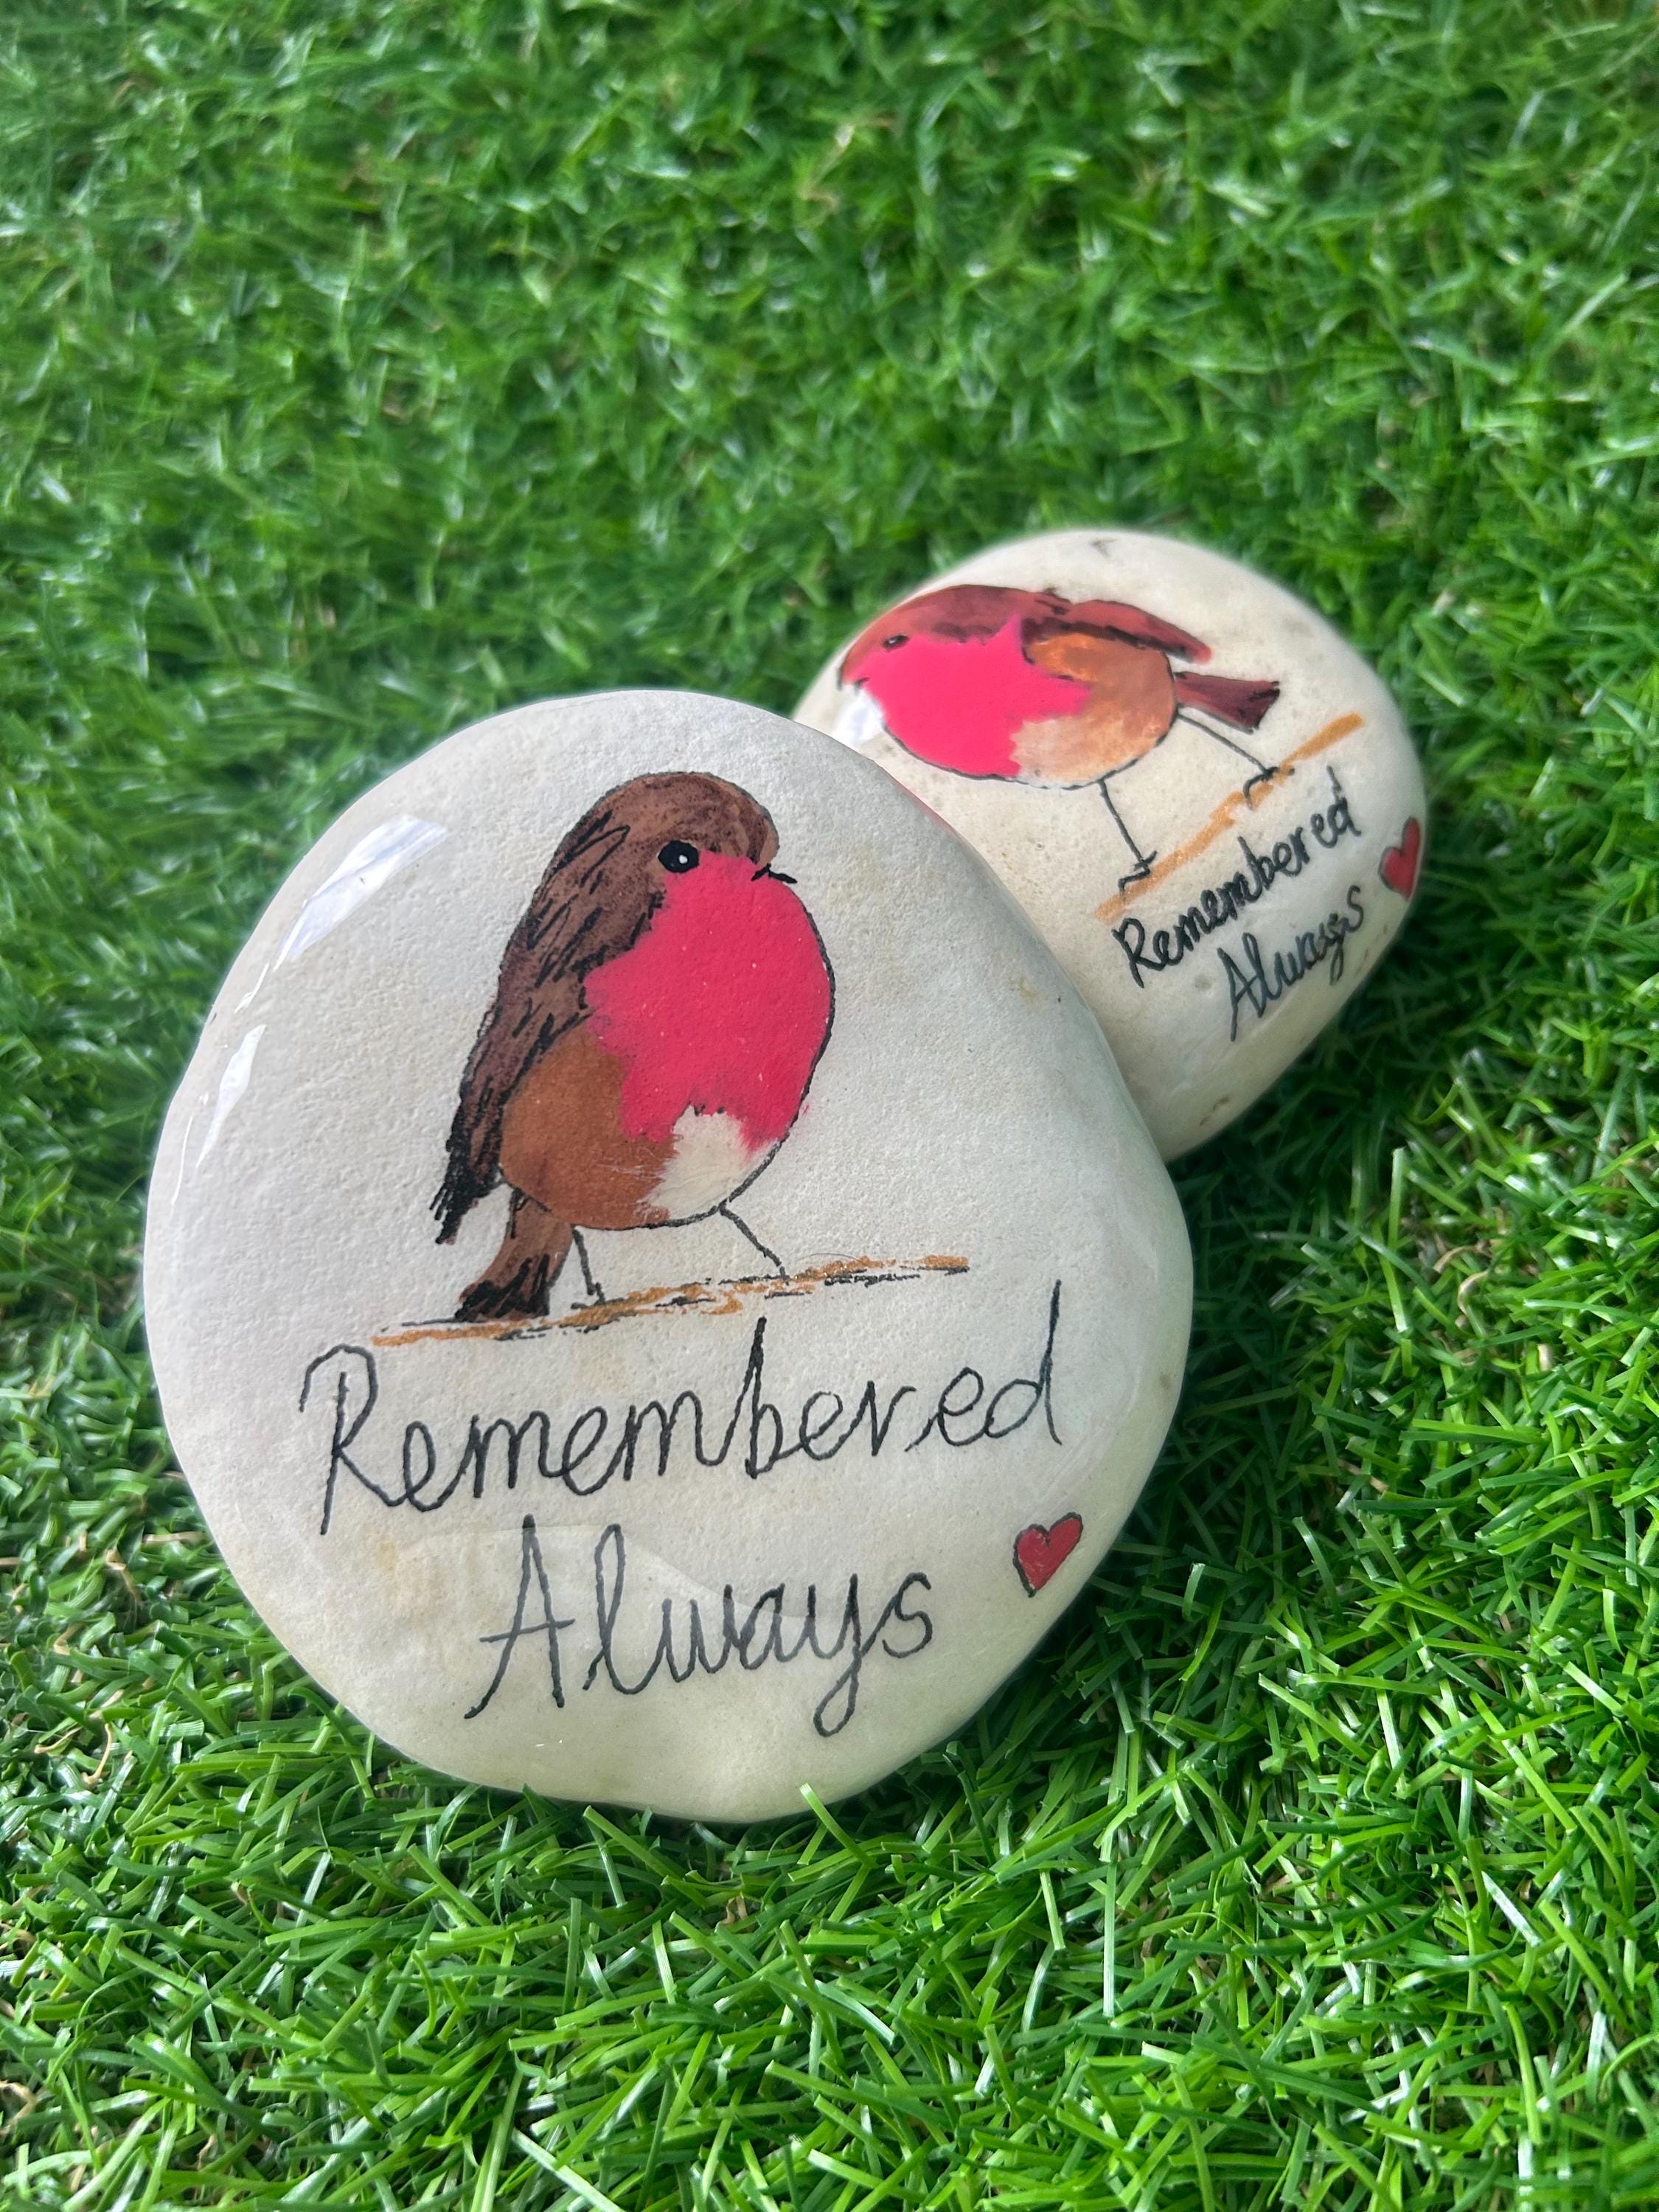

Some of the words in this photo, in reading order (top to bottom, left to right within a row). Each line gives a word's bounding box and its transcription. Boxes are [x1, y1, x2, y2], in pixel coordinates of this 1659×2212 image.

[1111, 765, 1362, 989] Remembered
[1217, 885, 1364, 1043] Always
[299, 1279, 1065, 1536] Remembered
[464, 1514, 934, 1739] Always
